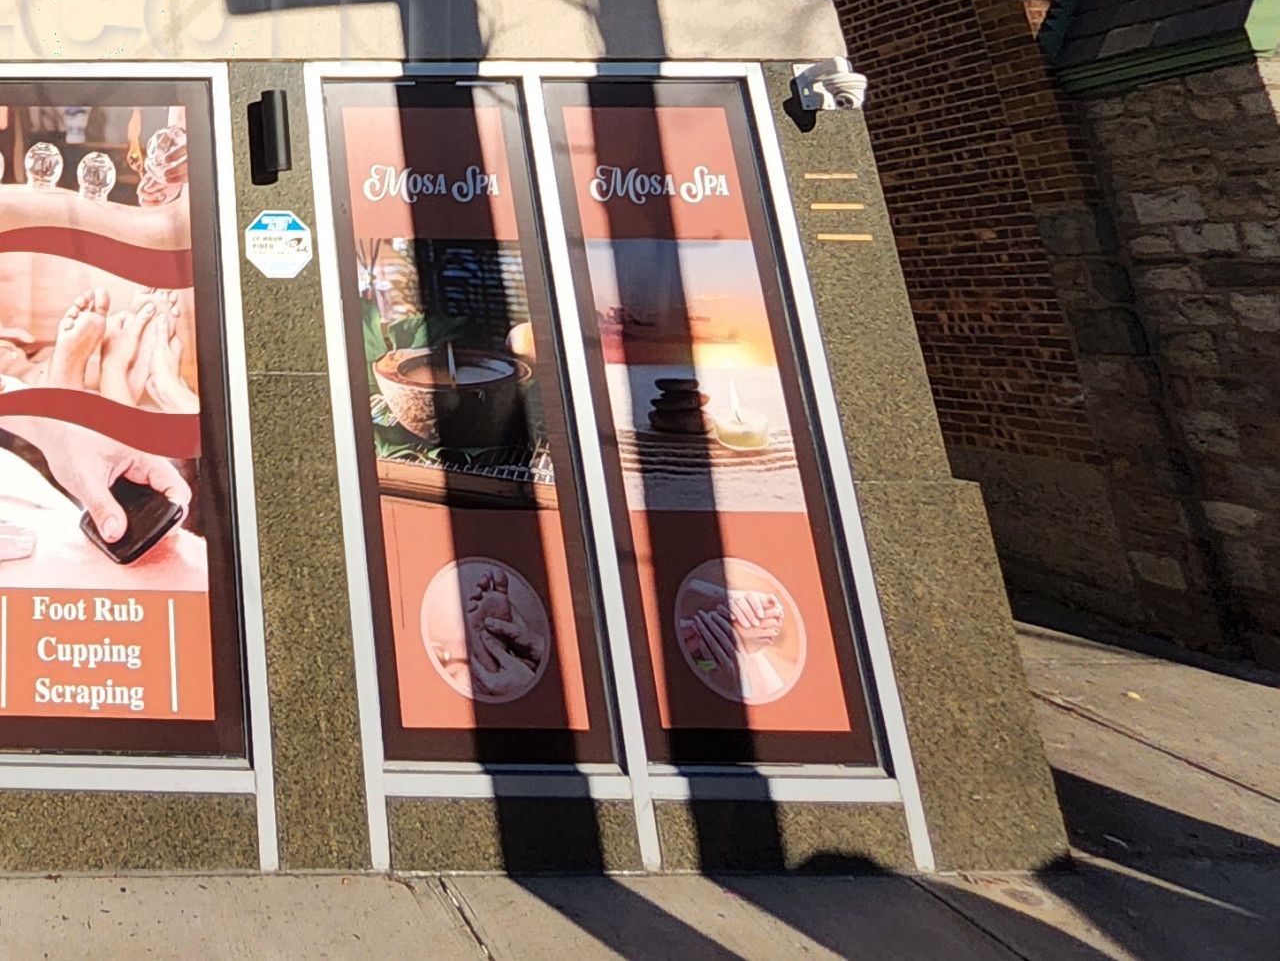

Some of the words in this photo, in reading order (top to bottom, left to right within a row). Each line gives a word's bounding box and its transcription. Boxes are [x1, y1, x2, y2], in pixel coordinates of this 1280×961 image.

[31, 596, 87, 621] Foot
[93, 597, 144, 622] Rub
[37, 636, 142, 669] Cupping
[34, 677, 144, 711] Scraping
